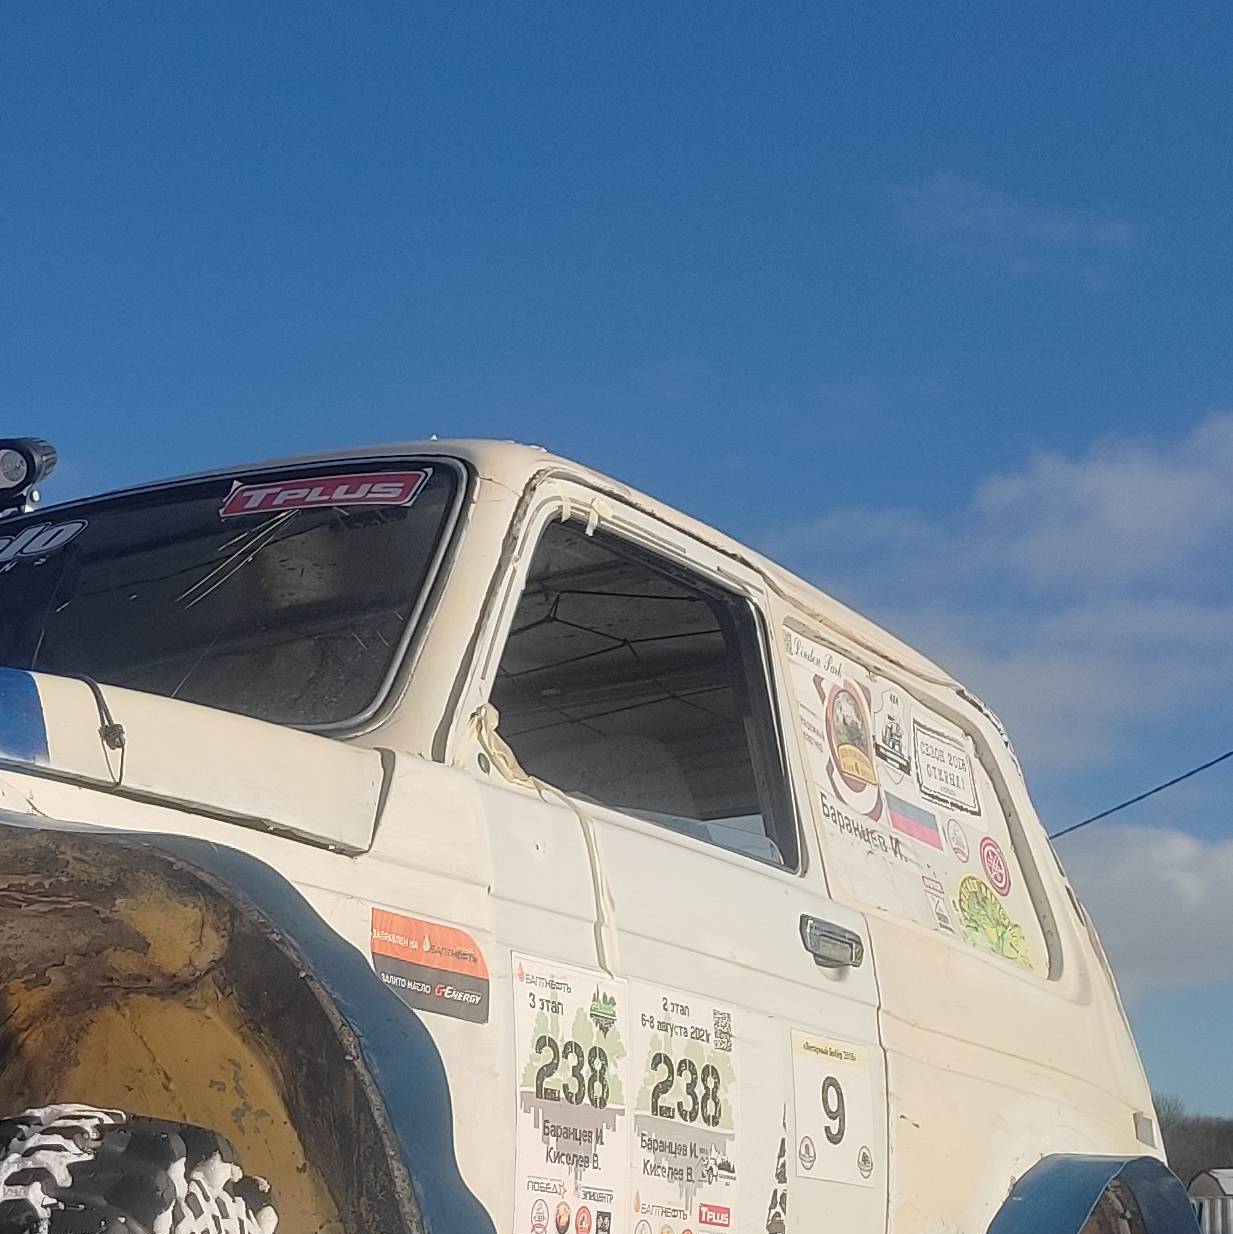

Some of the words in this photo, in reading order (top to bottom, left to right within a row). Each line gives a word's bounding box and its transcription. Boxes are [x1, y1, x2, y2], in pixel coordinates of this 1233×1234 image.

[243, 482, 404, 509] TPLUS
[535, 1035, 610, 1109] 238
[651, 1052, 722, 1127] 238
[543, 1119, 593, 1146] Баранцев
[821, 1075, 846, 1145] 9
